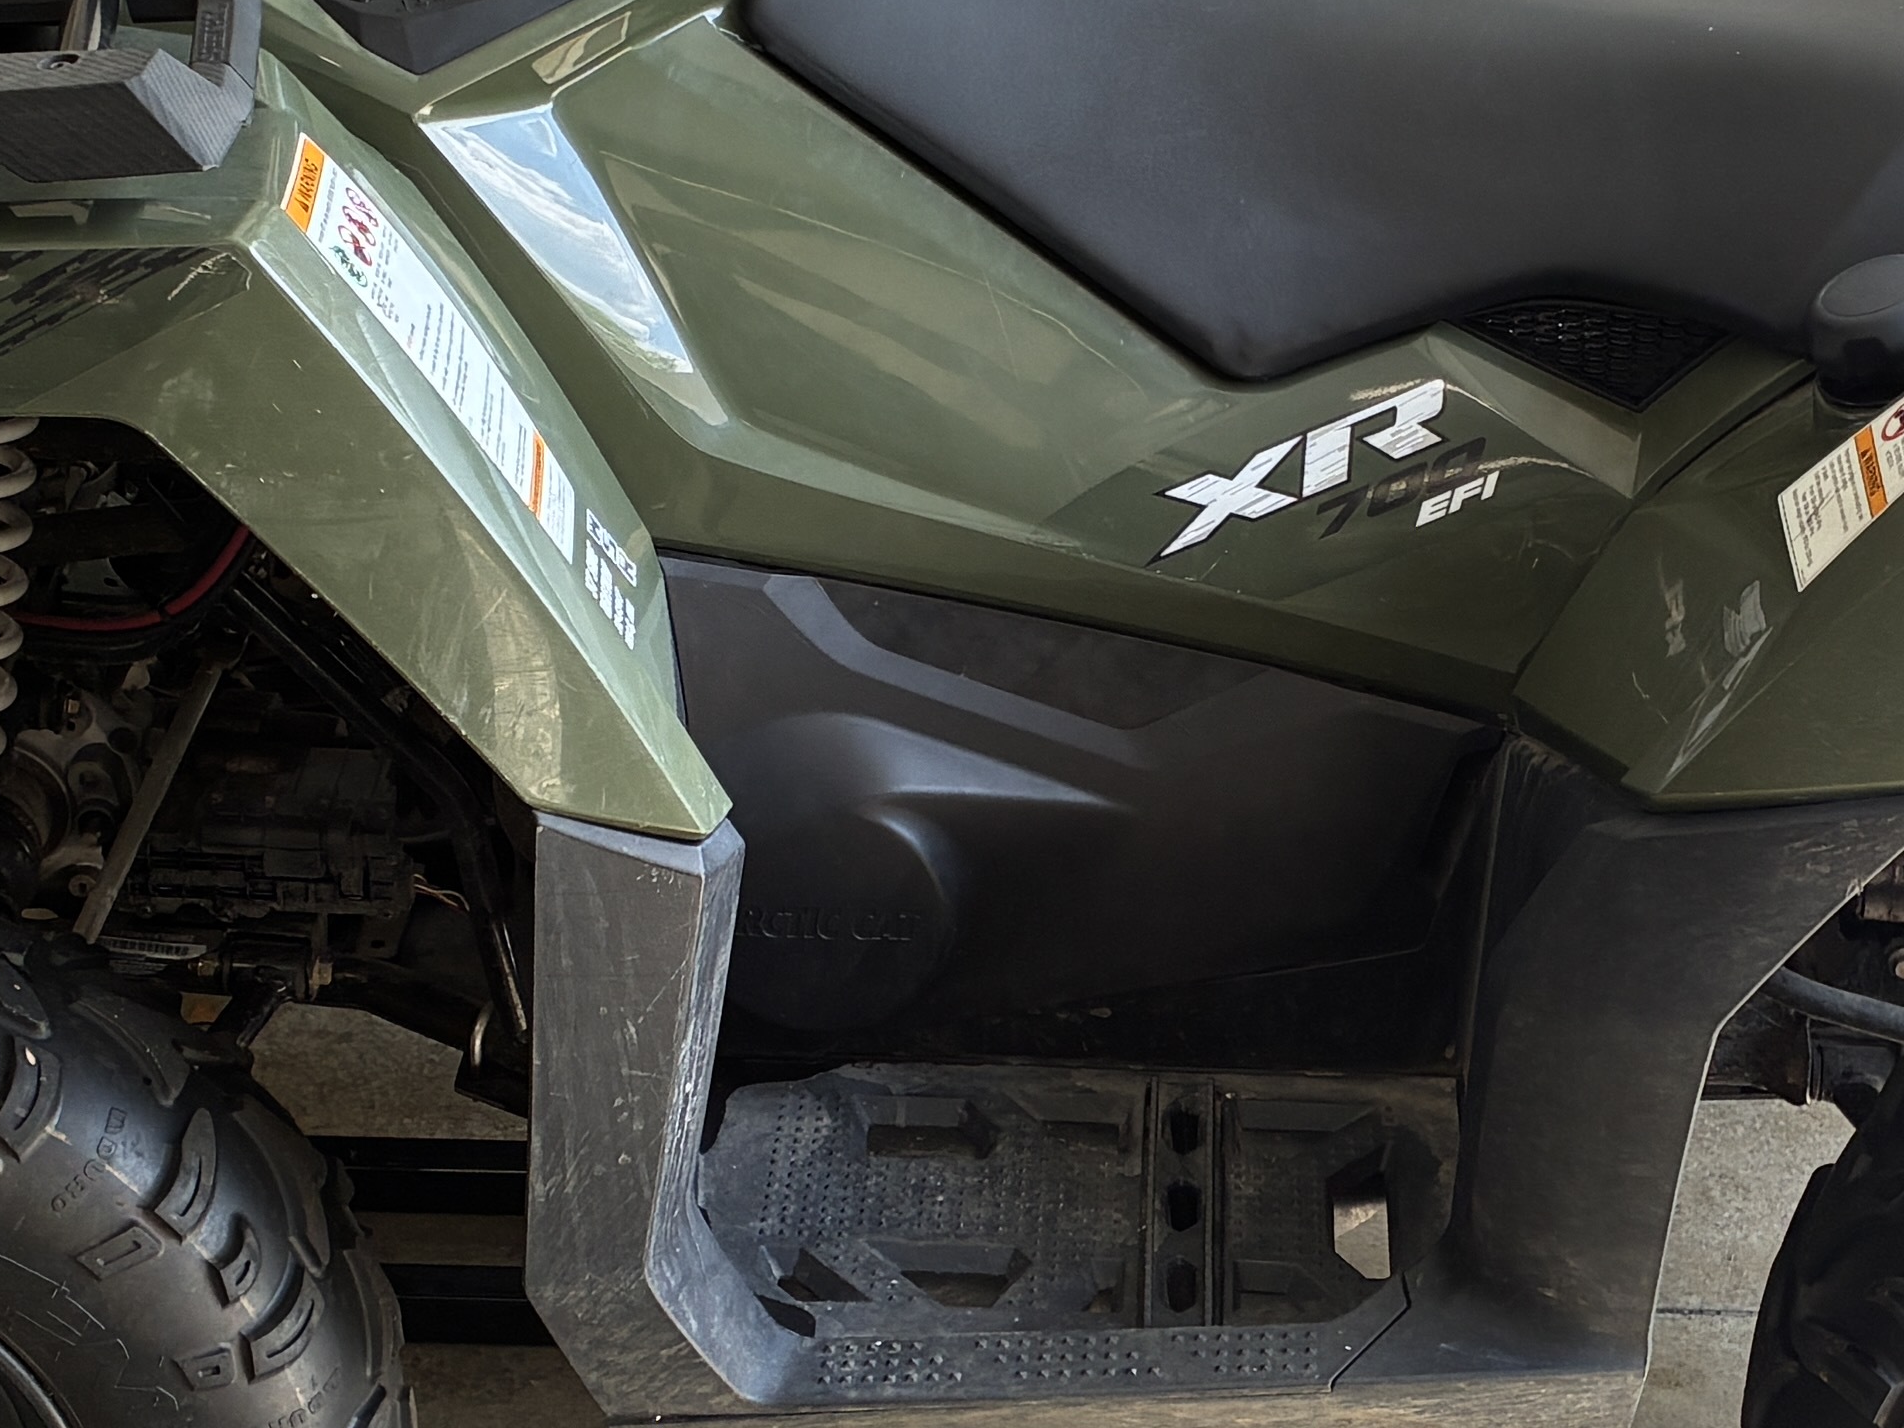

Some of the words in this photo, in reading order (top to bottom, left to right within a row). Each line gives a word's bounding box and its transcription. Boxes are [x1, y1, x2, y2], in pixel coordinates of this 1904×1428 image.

[1144, 378, 1449, 567] XR
[1316, 437, 1487, 540] 700
[1414, 470, 1502, 529] EFI
